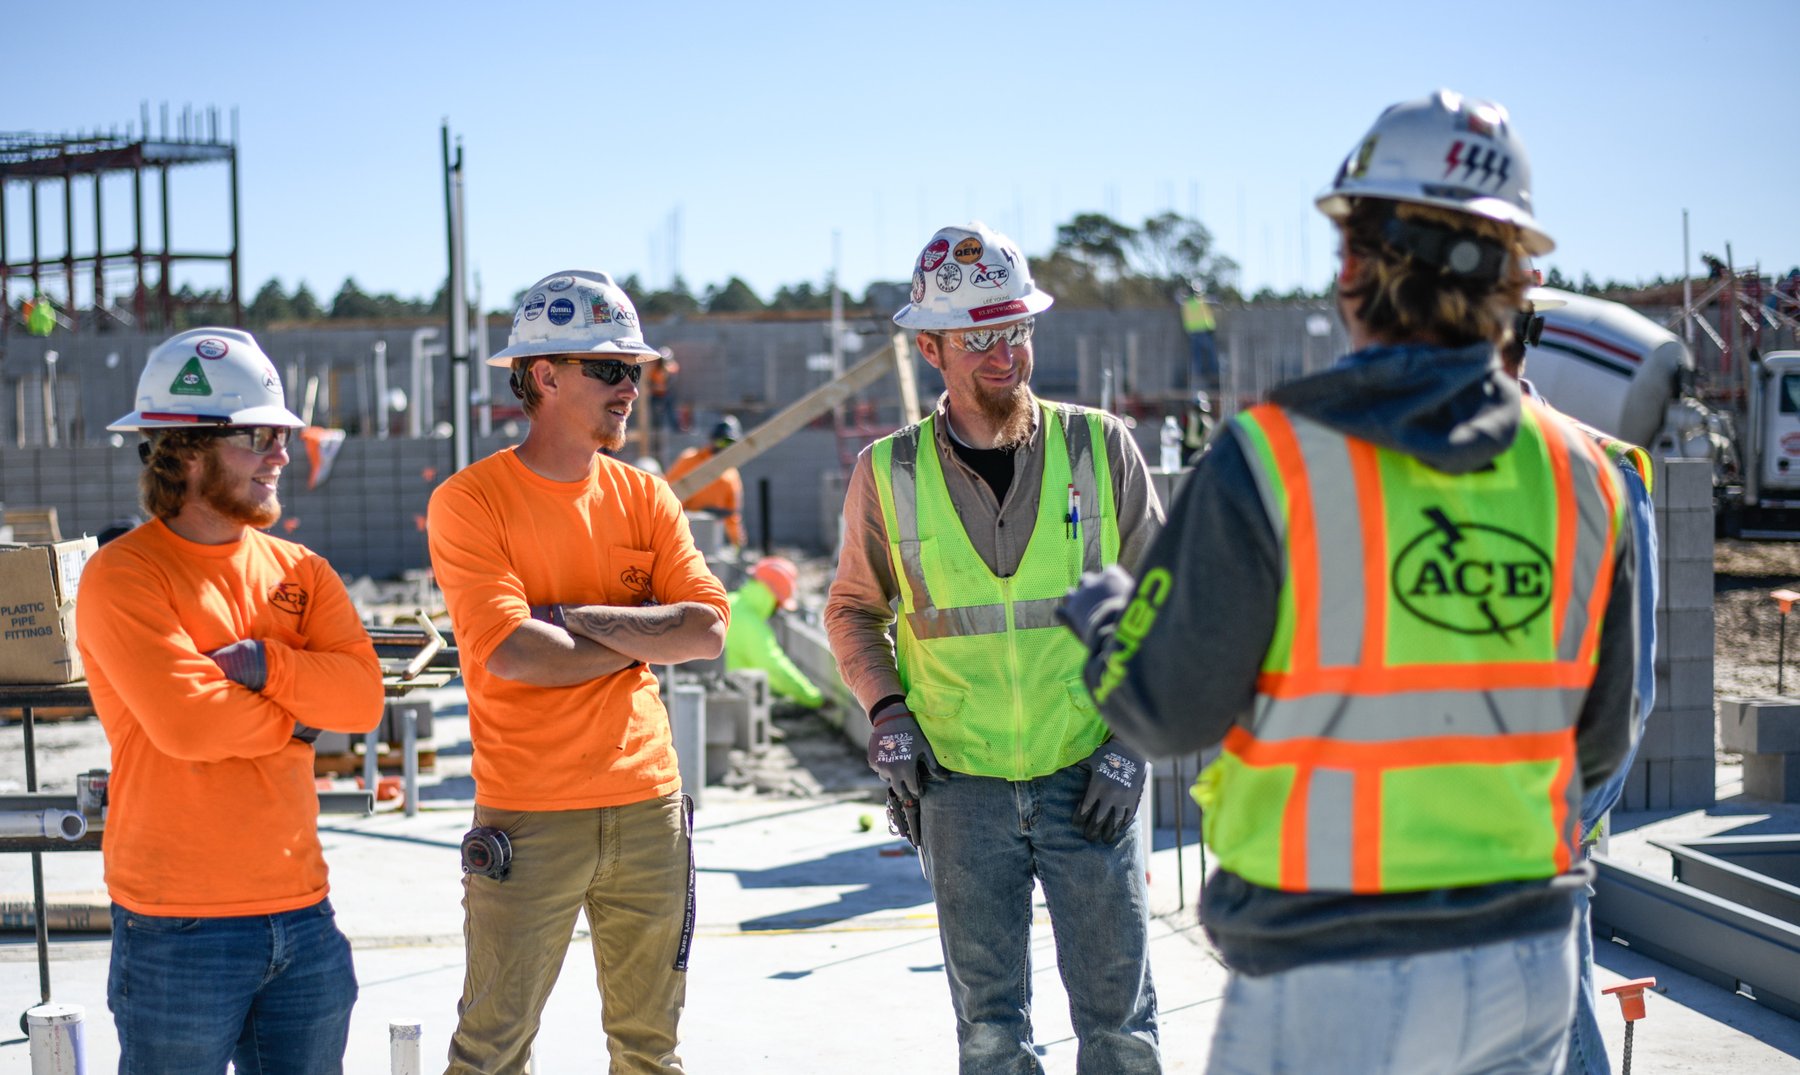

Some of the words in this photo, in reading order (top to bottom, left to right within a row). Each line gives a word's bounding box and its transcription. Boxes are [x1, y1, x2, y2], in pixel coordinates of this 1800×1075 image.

[973, 269, 1008, 284] ACE
[978, 303, 1022, 316] ELECTRICIAN
[1408, 560, 1543, 597] ACE
[273, 592, 306, 606] ACE
[0, 602, 45, 616] PLASTIC
[12, 616, 36, 627] PIPE
[5, 626, 52, 640] FITTINGS
[684, 912, 692, 932] don't
[680, 934, 688, 956] care.
